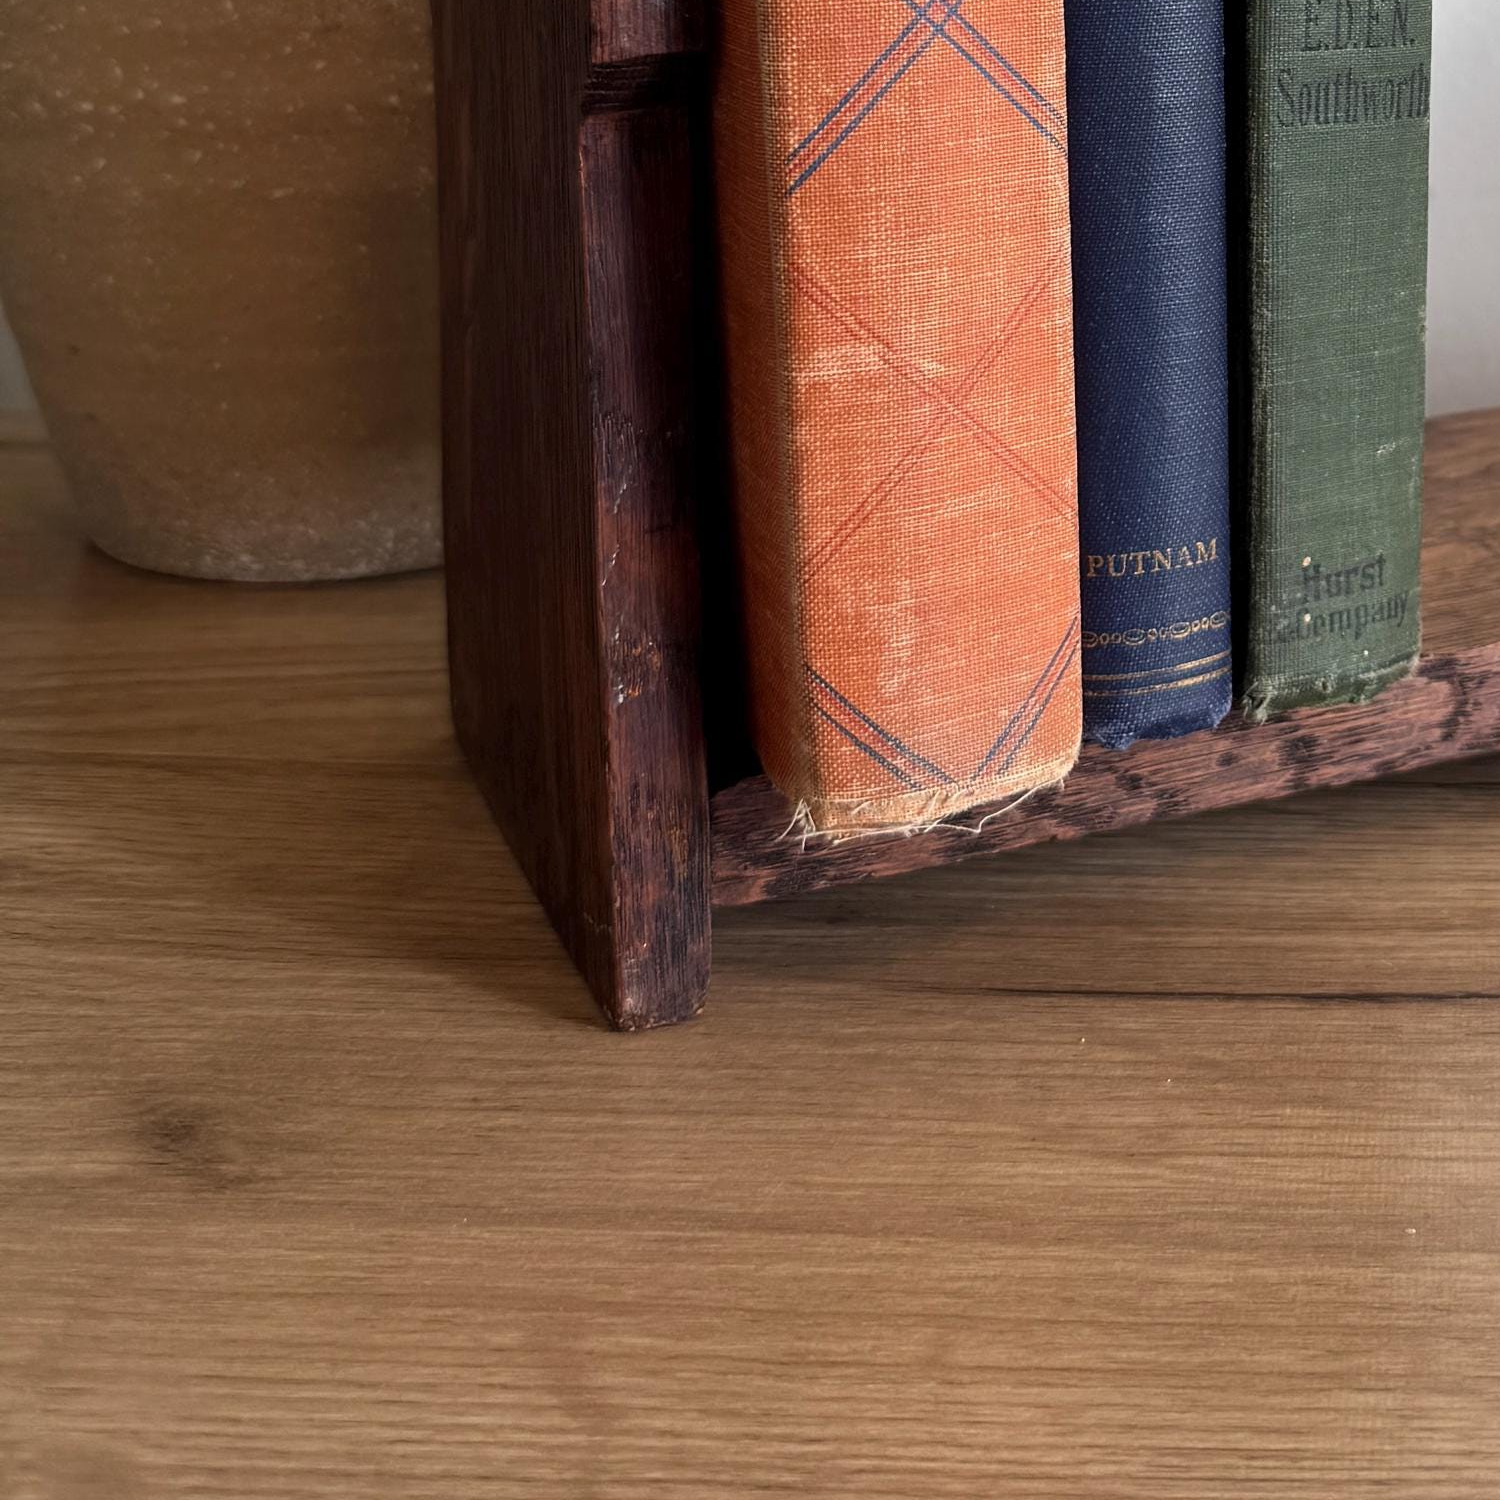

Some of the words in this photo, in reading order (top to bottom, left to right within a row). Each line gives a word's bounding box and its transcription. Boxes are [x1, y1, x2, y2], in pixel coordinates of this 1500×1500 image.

[1276, 62, 1432, 128] Southworth
[1086, 536, 1220, 578] PUTNAM
[1300, 552, 1386, 603] Hurst
